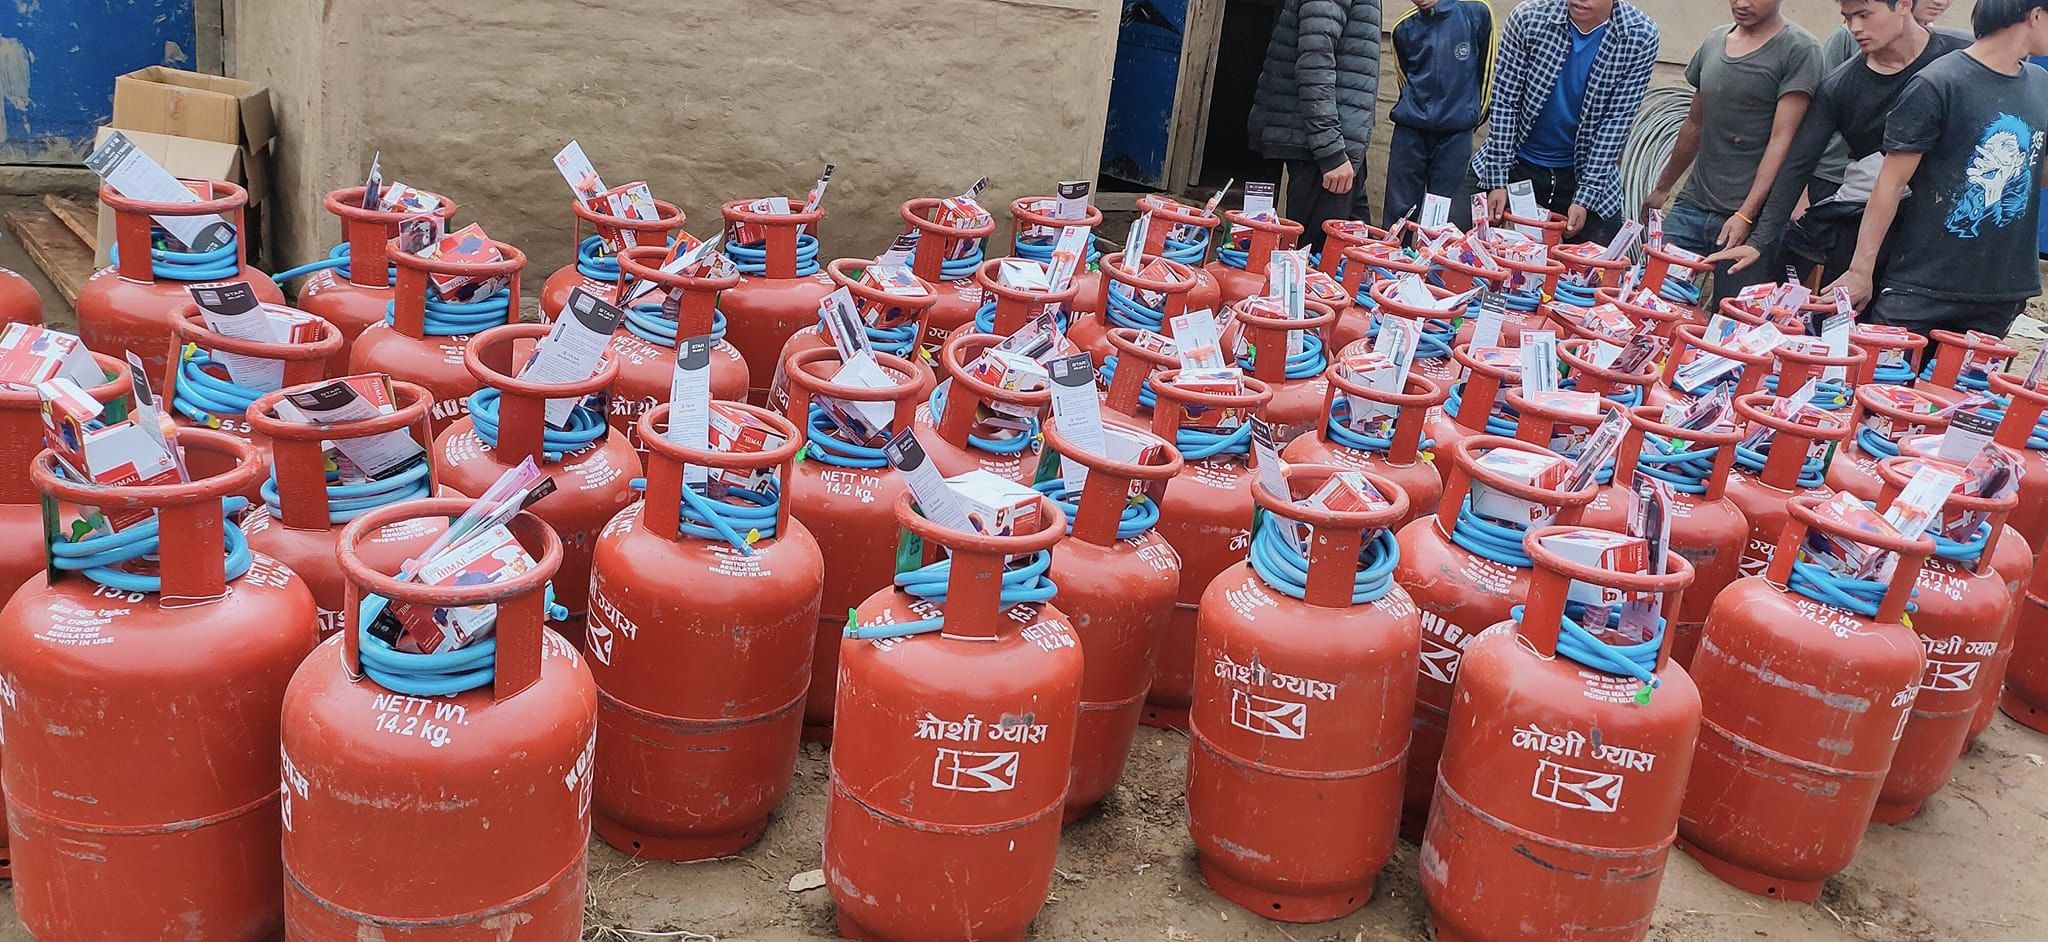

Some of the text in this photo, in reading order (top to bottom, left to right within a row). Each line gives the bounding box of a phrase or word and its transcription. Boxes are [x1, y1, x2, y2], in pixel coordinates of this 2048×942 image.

[432, 396, 470, 421] KOS
[821, 470, 882, 490] NETT WT.
[825, 481, 852, 496] 14.2
[1271, 671, 1338, 701] ग्यास
[371, 693, 470, 725] NETT WT.
[375, 713, 452, 748] 14.2 kg.
[1511, 722, 1657, 773] कोशी ग्यास
